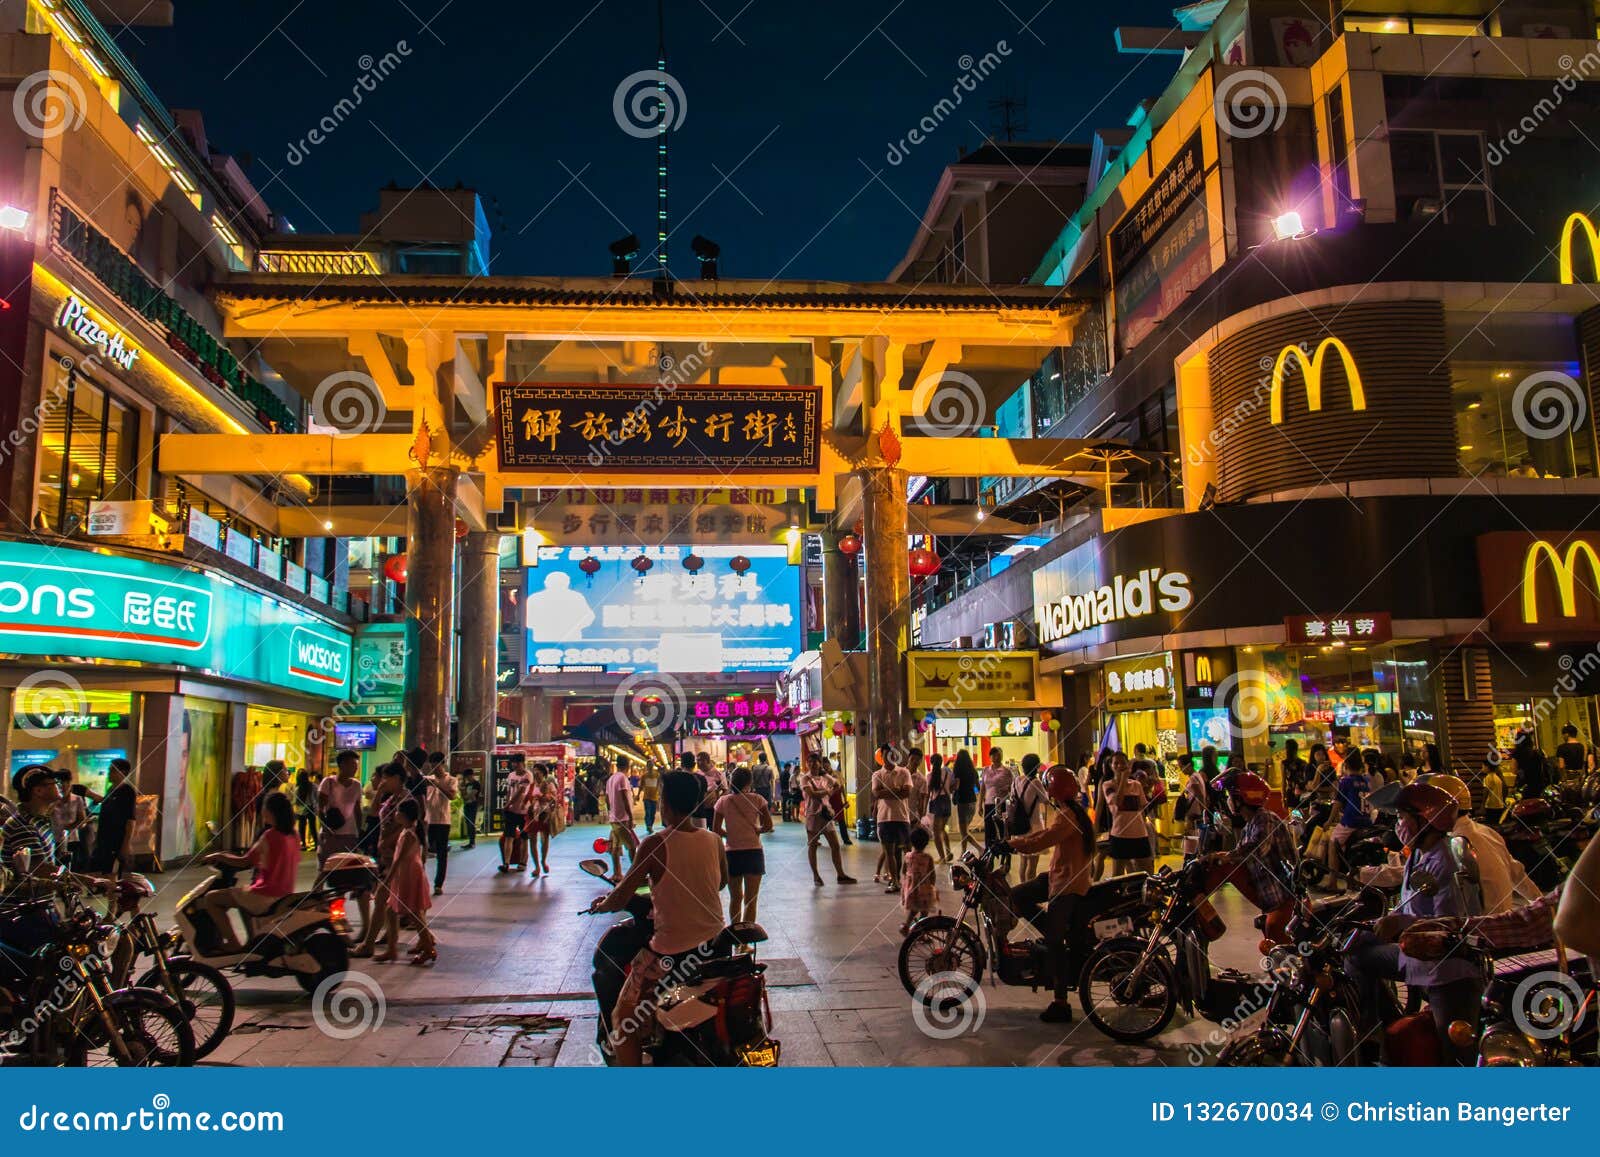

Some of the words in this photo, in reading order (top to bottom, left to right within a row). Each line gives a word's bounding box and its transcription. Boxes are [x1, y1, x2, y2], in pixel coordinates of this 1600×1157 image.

[61, 296, 108, 346] Pizza
[107, 333, 140, 370] Hut
[521, 405, 778, 451] 解放路步行街
[123, 591, 197, 633] 屈臣氏
[1038, 568, 1193, 644] McDonald's
[1305, 619, 1375, 637] 麦当劳
[298, 641, 341, 672] watsons
[58, 716, 90, 726] VICHY
